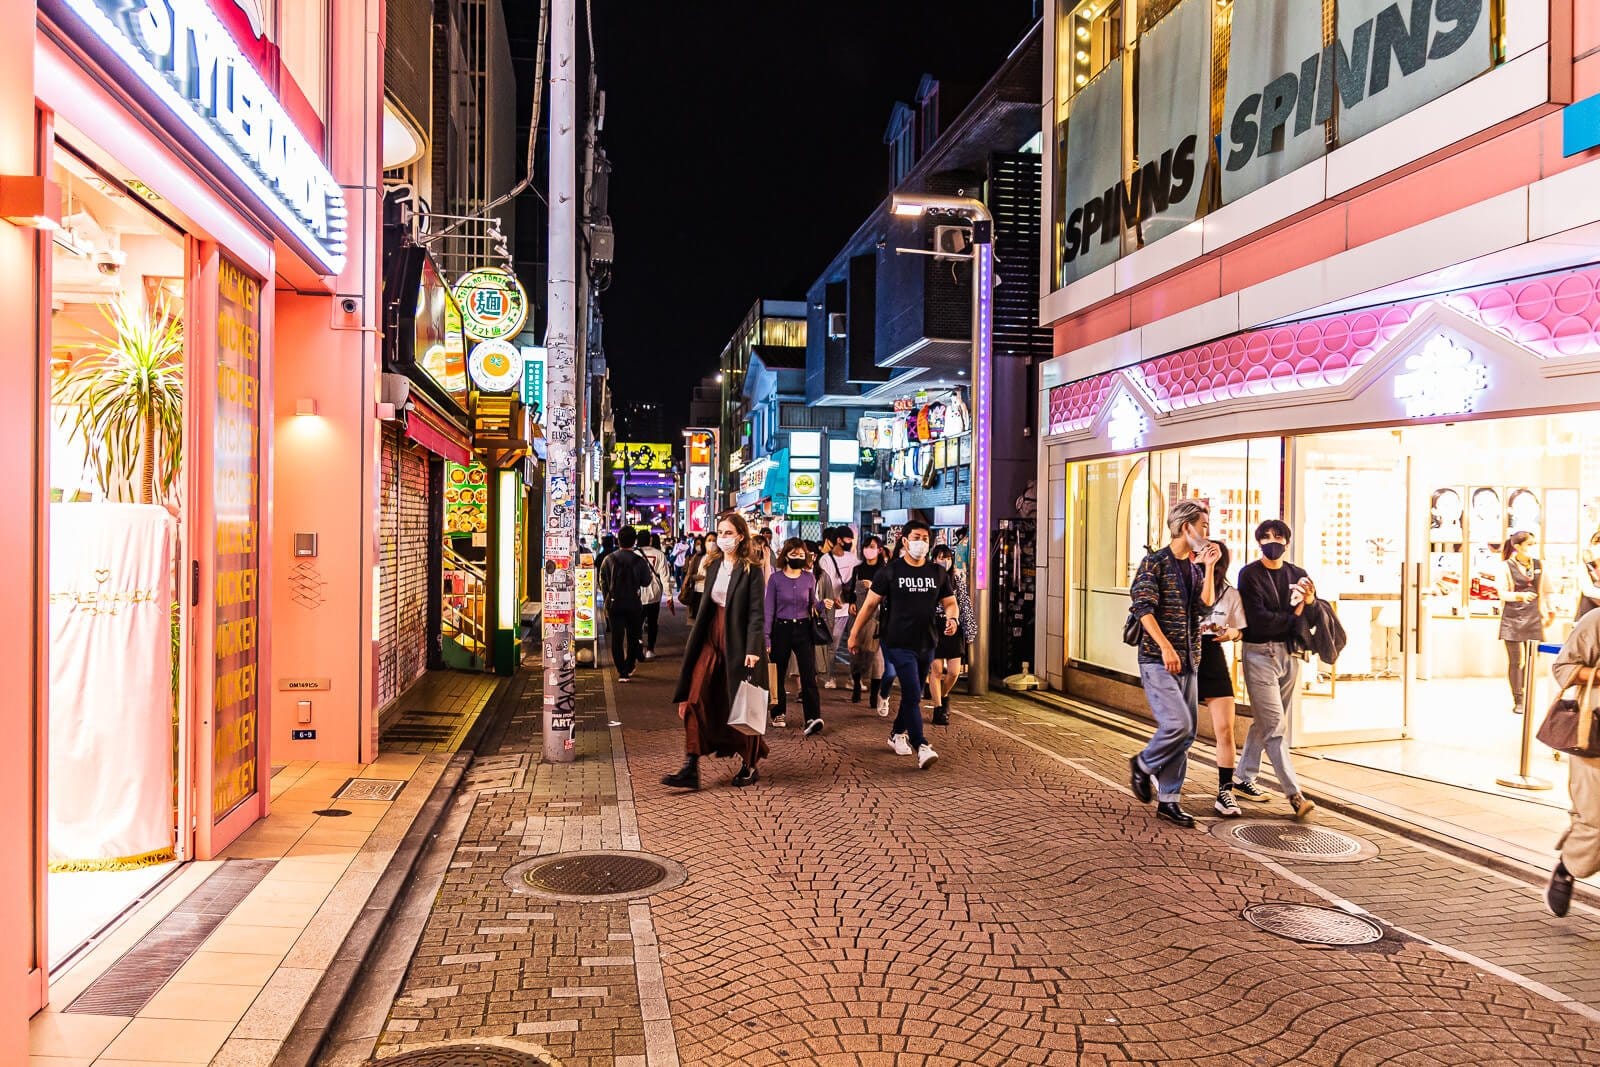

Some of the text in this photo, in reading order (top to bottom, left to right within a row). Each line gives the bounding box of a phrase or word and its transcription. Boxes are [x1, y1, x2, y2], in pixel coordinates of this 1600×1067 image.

[1224, 0, 1482, 172] SPINNS
[1064, 134, 1198, 263] SPINNS
[219, 258, 259, 316] MICKEY
[476, 290, 501, 316] 麺
[216, 568, 258, 608] MICKEY
[898, 577, 937, 589] POLO RL
[216, 616, 257, 660] MICKEY
[216, 662, 257, 712] MICKEY
[215, 709, 256, 764] MICKEY
[552, 718, 571, 728] ART
